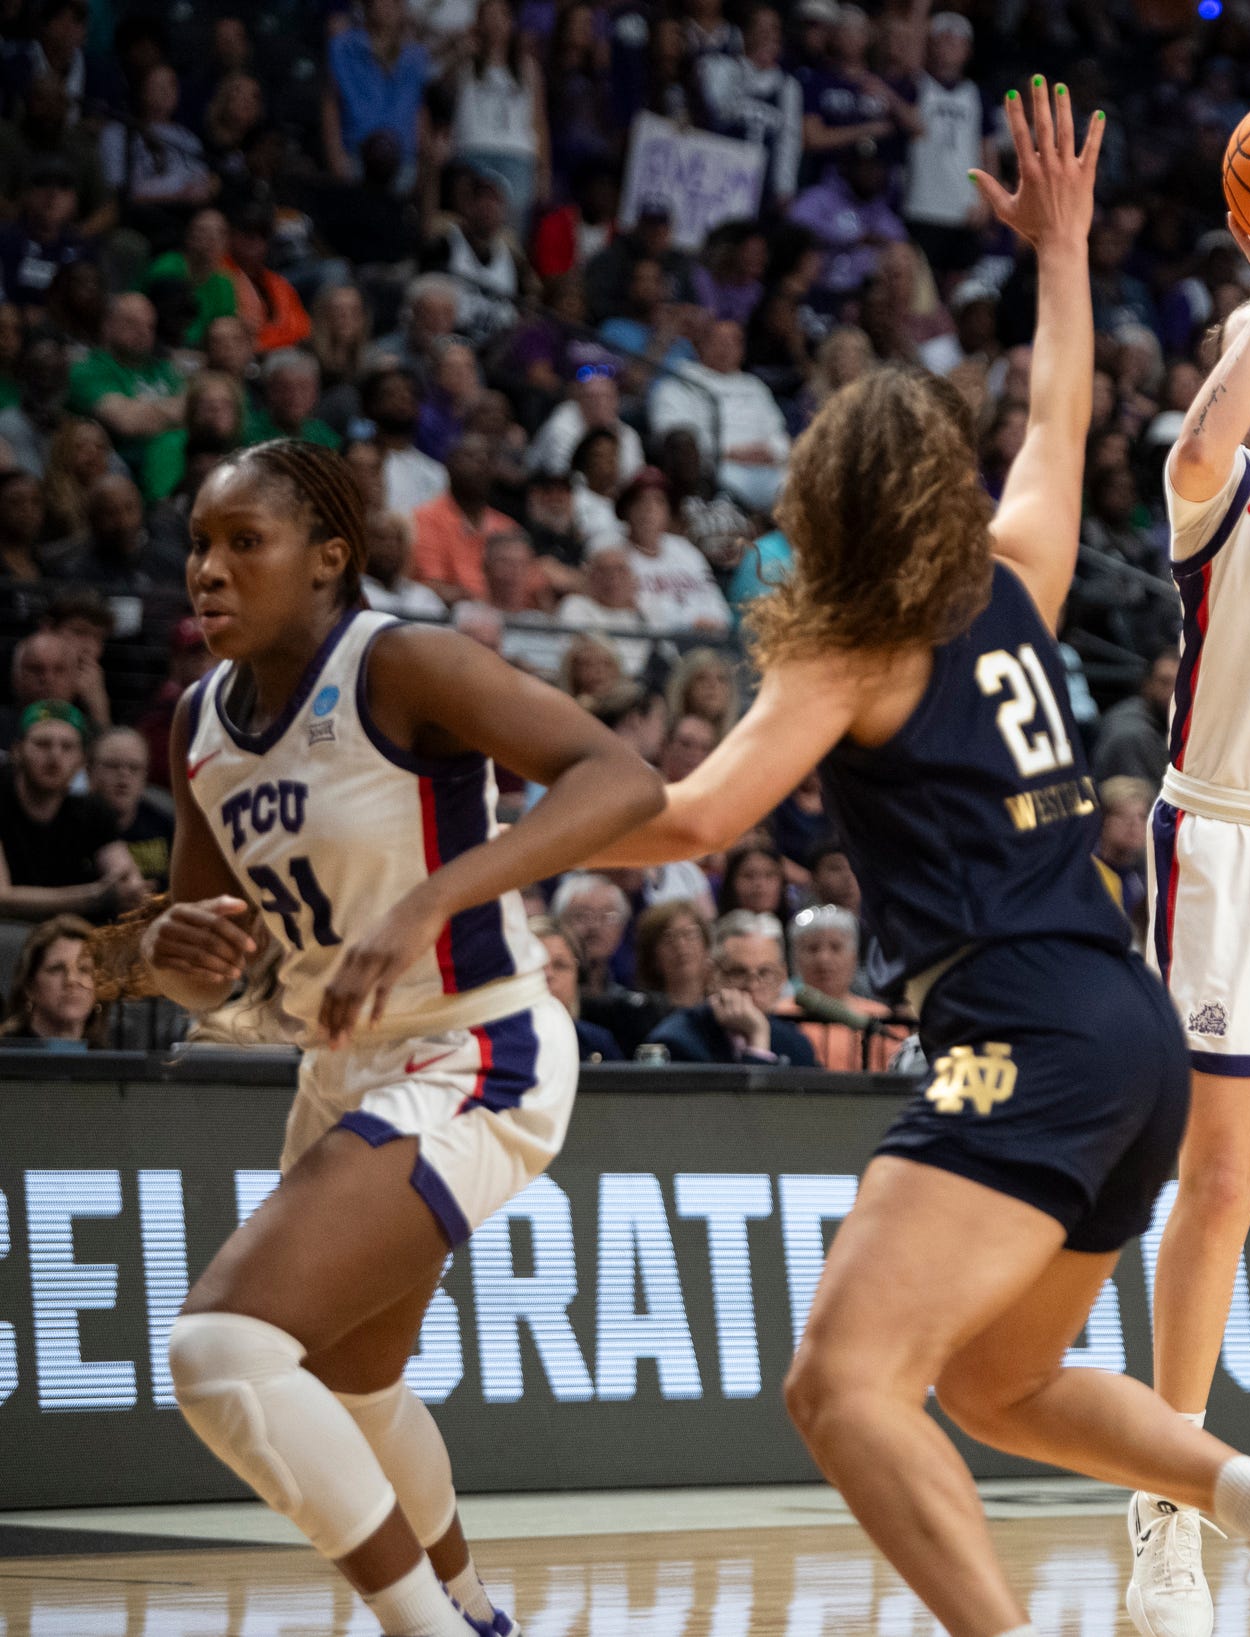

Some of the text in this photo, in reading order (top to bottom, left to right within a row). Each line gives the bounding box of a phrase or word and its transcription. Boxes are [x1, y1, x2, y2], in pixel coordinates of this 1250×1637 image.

[974, 643, 1075, 779] 21
[221, 779, 308, 854] TCU
[0, 1169, 858, 1413] ELRAT
